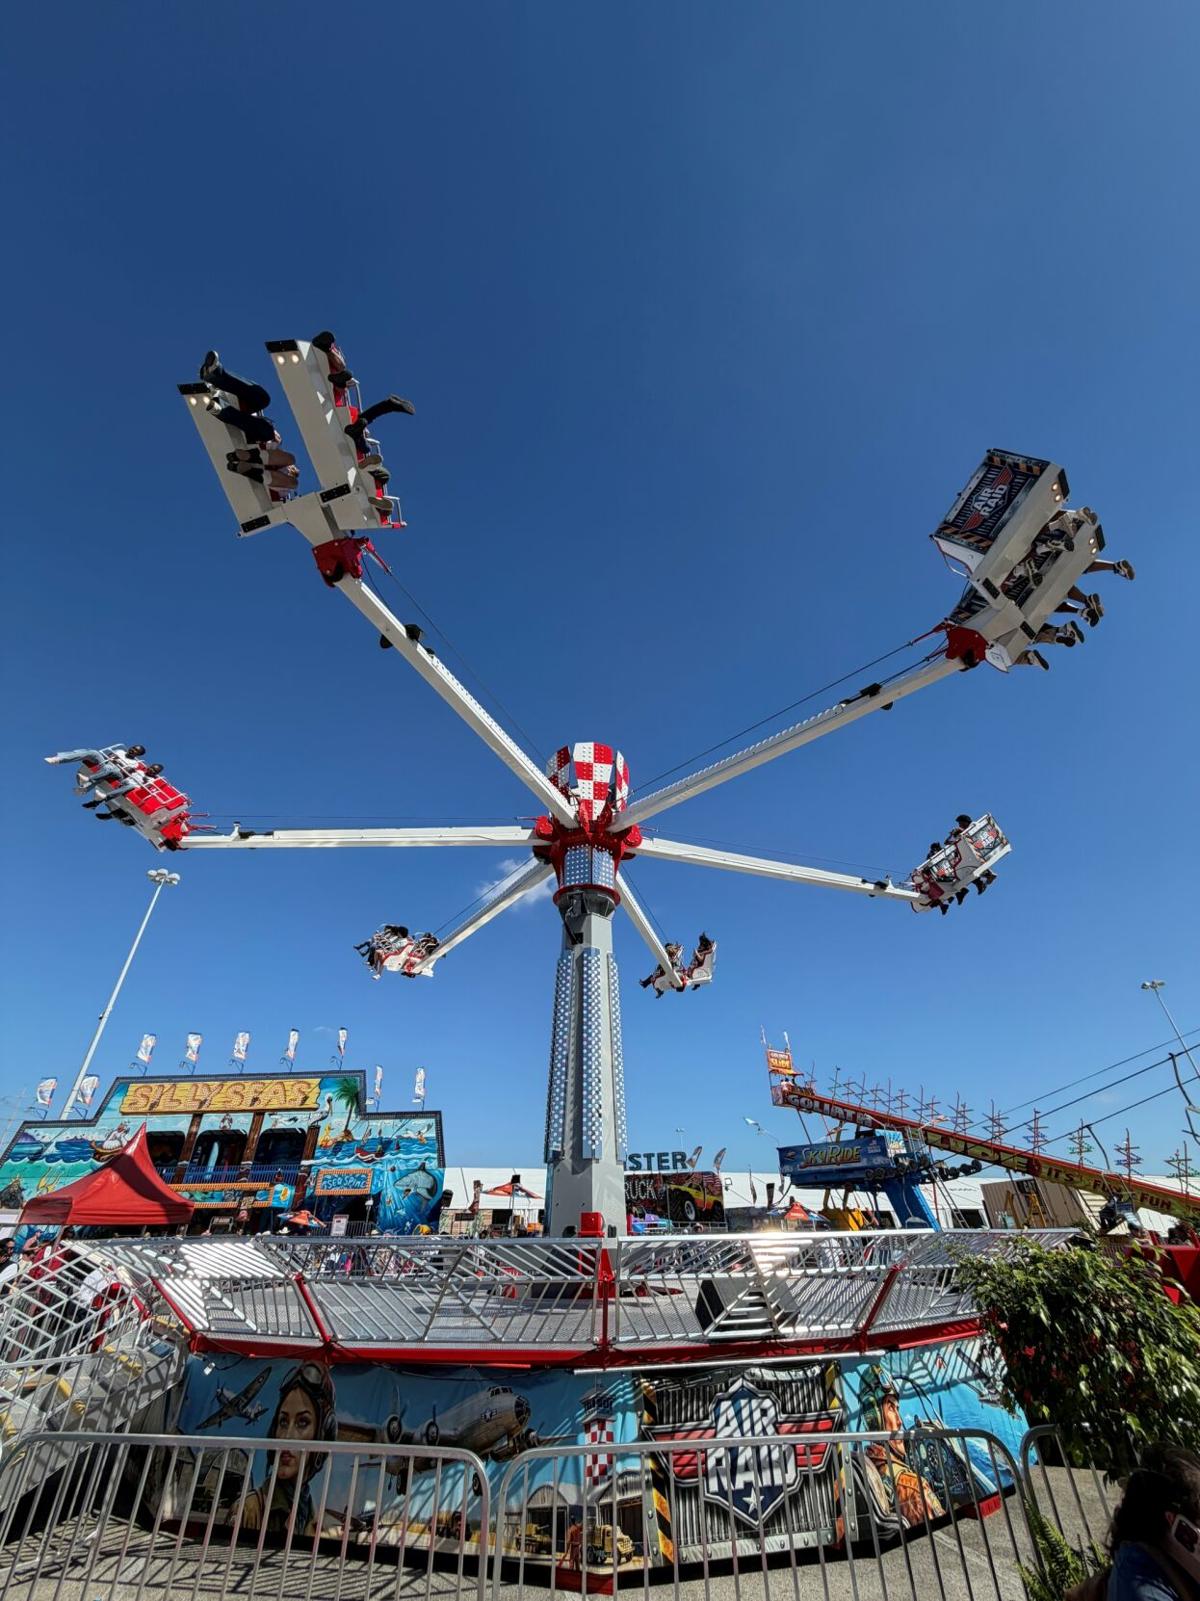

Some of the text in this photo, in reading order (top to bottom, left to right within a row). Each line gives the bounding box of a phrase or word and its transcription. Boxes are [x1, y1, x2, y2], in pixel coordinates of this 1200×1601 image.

[973, 488, 994, 511] AIR
[980, 485, 1008, 516] RAID
[128, 1081, 311, 1111] SILLY SEAS
[624, 1152, 688, 1171] STER
[1139, 1192, 1172, 1211] FUN
[716, 1398, 778, 1438] AIR
[706, 1444, 797, 1493] RAID
